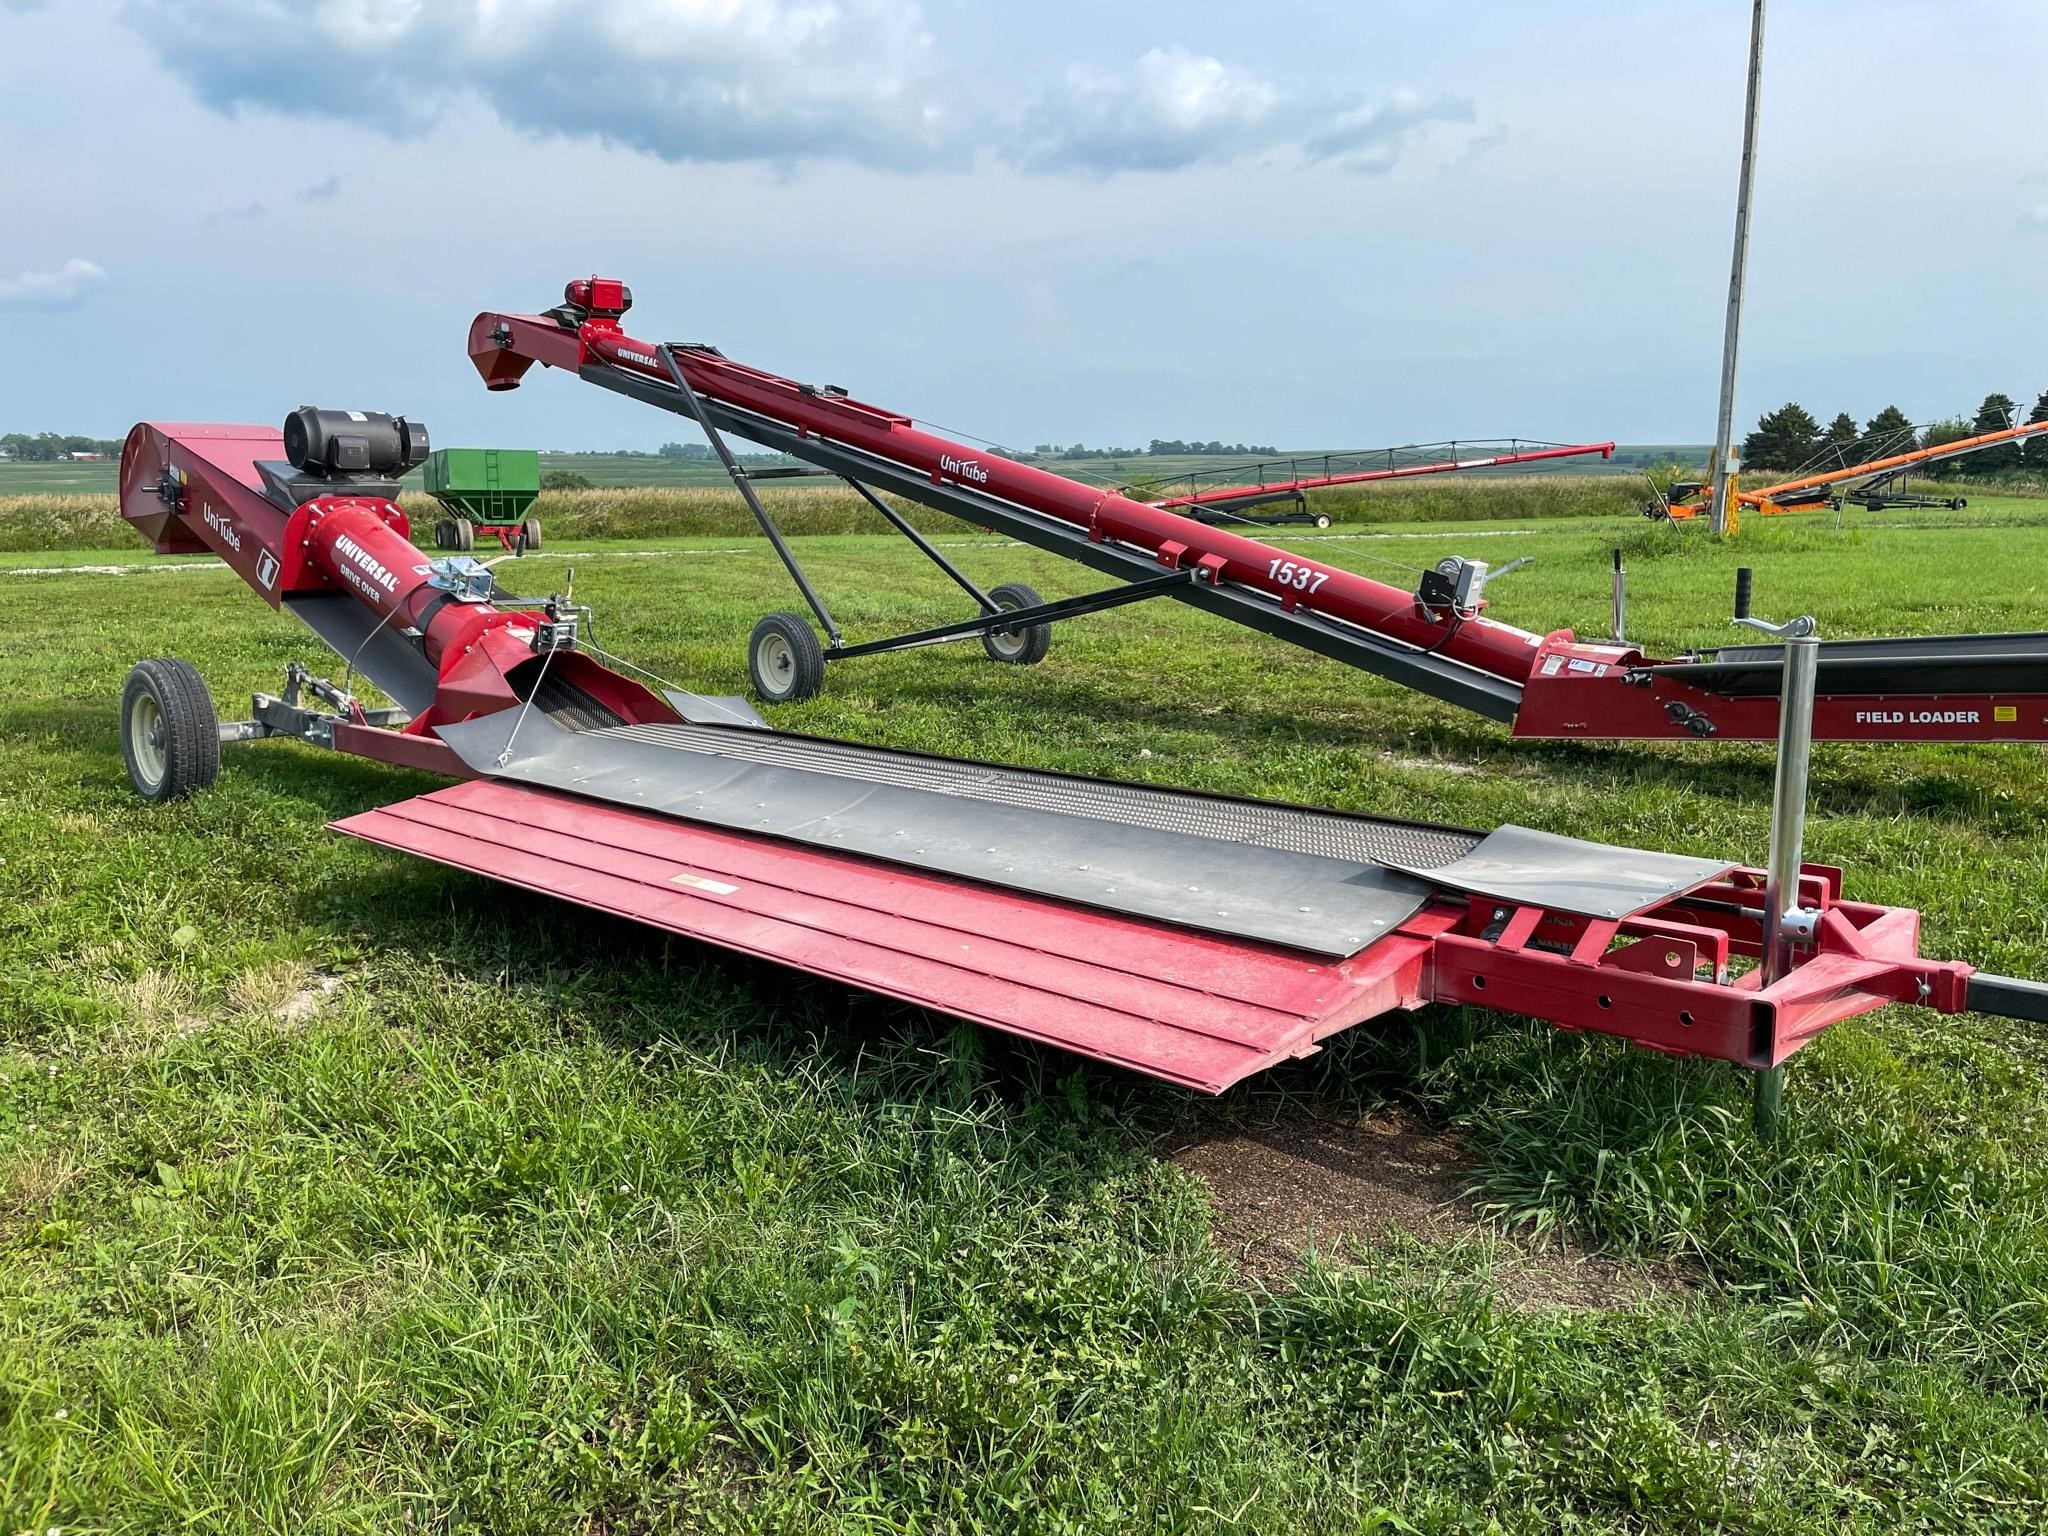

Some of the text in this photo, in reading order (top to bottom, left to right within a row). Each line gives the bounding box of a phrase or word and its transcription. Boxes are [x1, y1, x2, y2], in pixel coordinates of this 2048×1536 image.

[618, 348, 658, 367] UNIVERSAL
[940, 454, 988, 483] UniTube
[203, 502, 241, 552] UniTube
[335, 534, 397, 593] UNIVERSAL
[1268, 558, 1329, 594] 1537
[340, 563, 380, 603] DRIVE OVER
[1856, 711, 1904, 723] FIELD
[1909, 711, 1980, 723] LOADER
